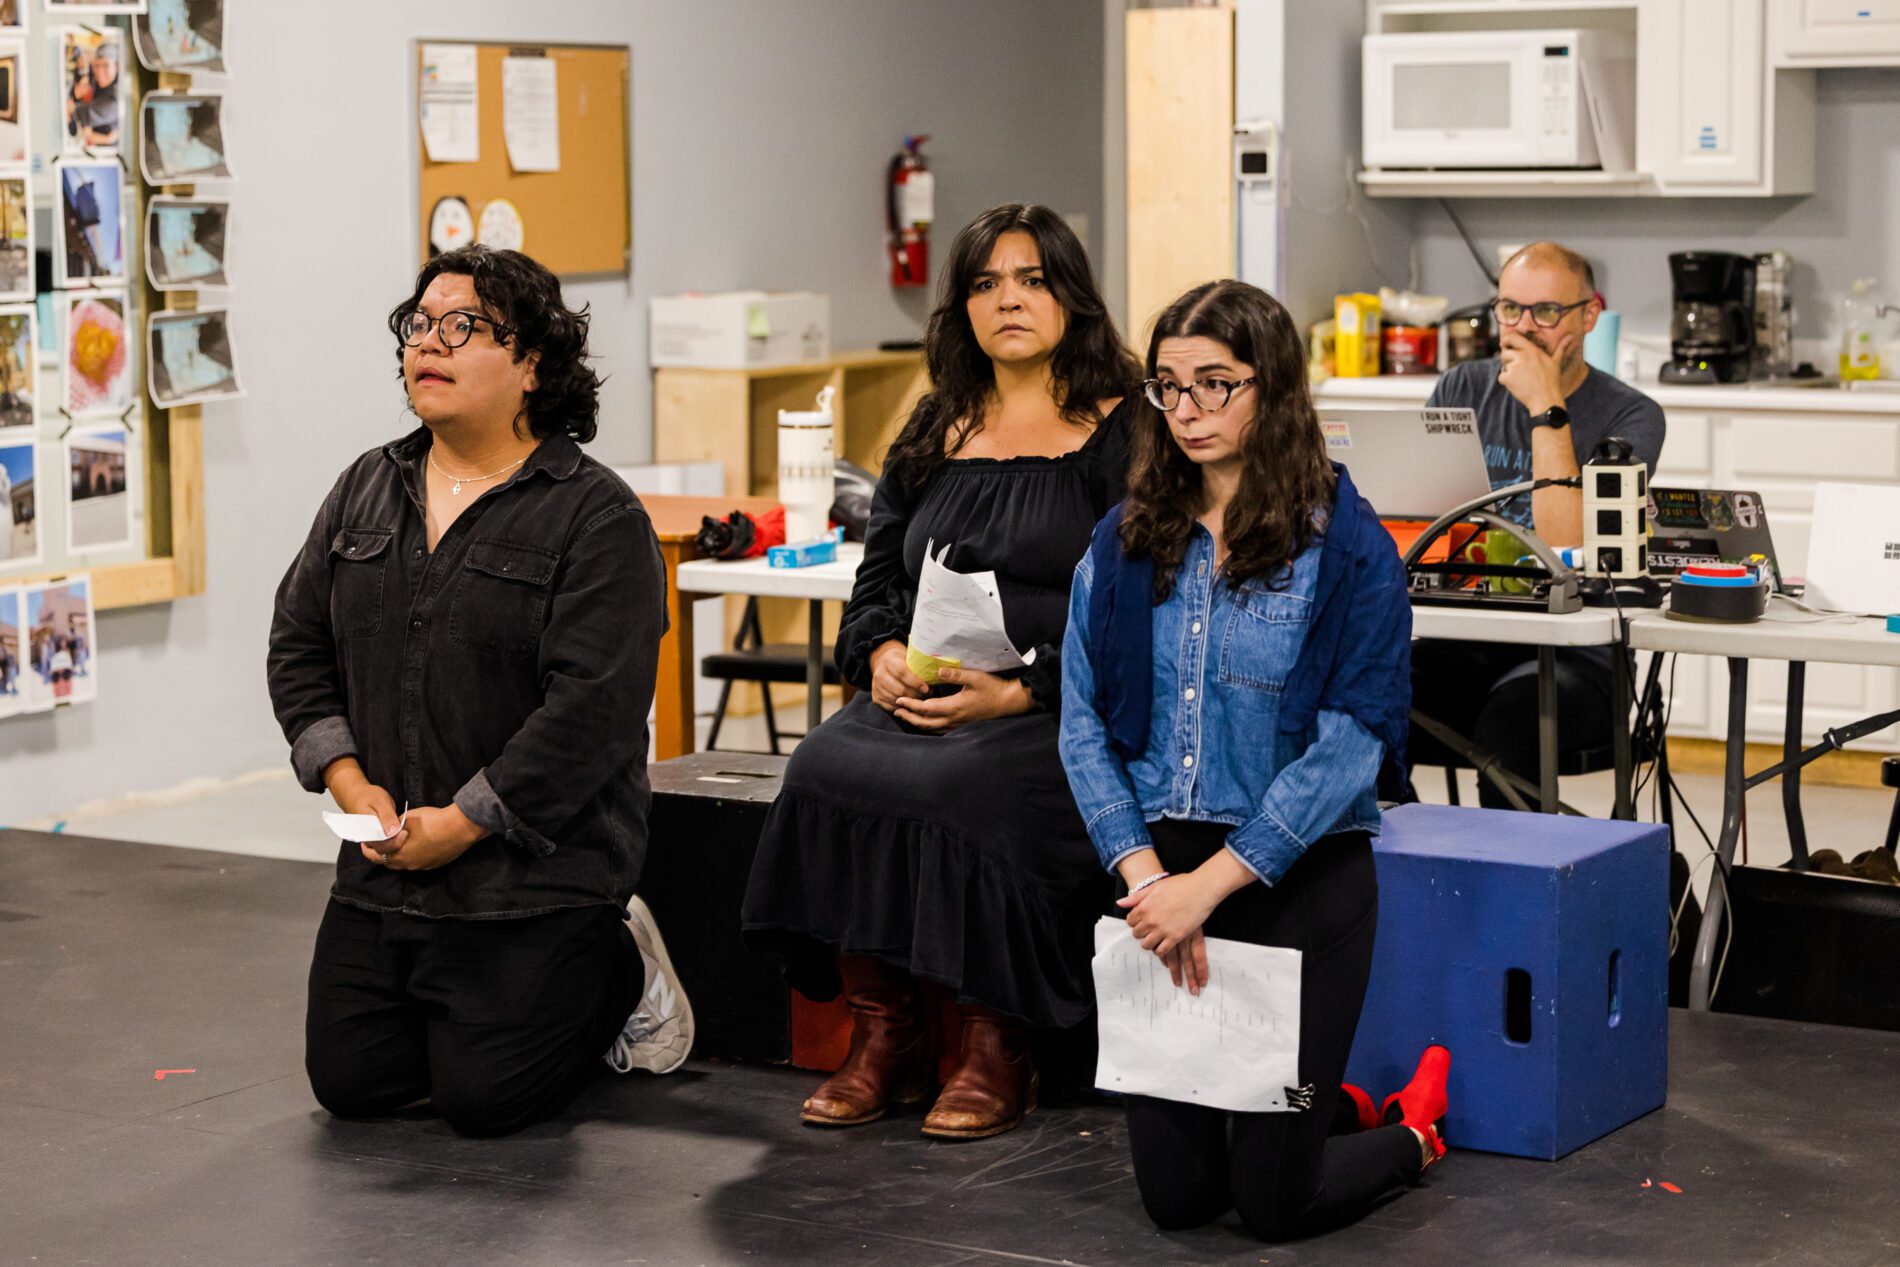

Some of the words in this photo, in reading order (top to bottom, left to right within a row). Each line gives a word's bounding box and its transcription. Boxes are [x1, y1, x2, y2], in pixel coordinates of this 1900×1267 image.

[1420, 411, 1425, 422] I
[1425, 411, 1442, 422] RUN
[1443, 411, 1449, 421] A
[1450, 411, 1472, 422] TIGHT
[1425, 423, 1474, 434] SHIPWRECK
[647, 968, 677, 1018] N
